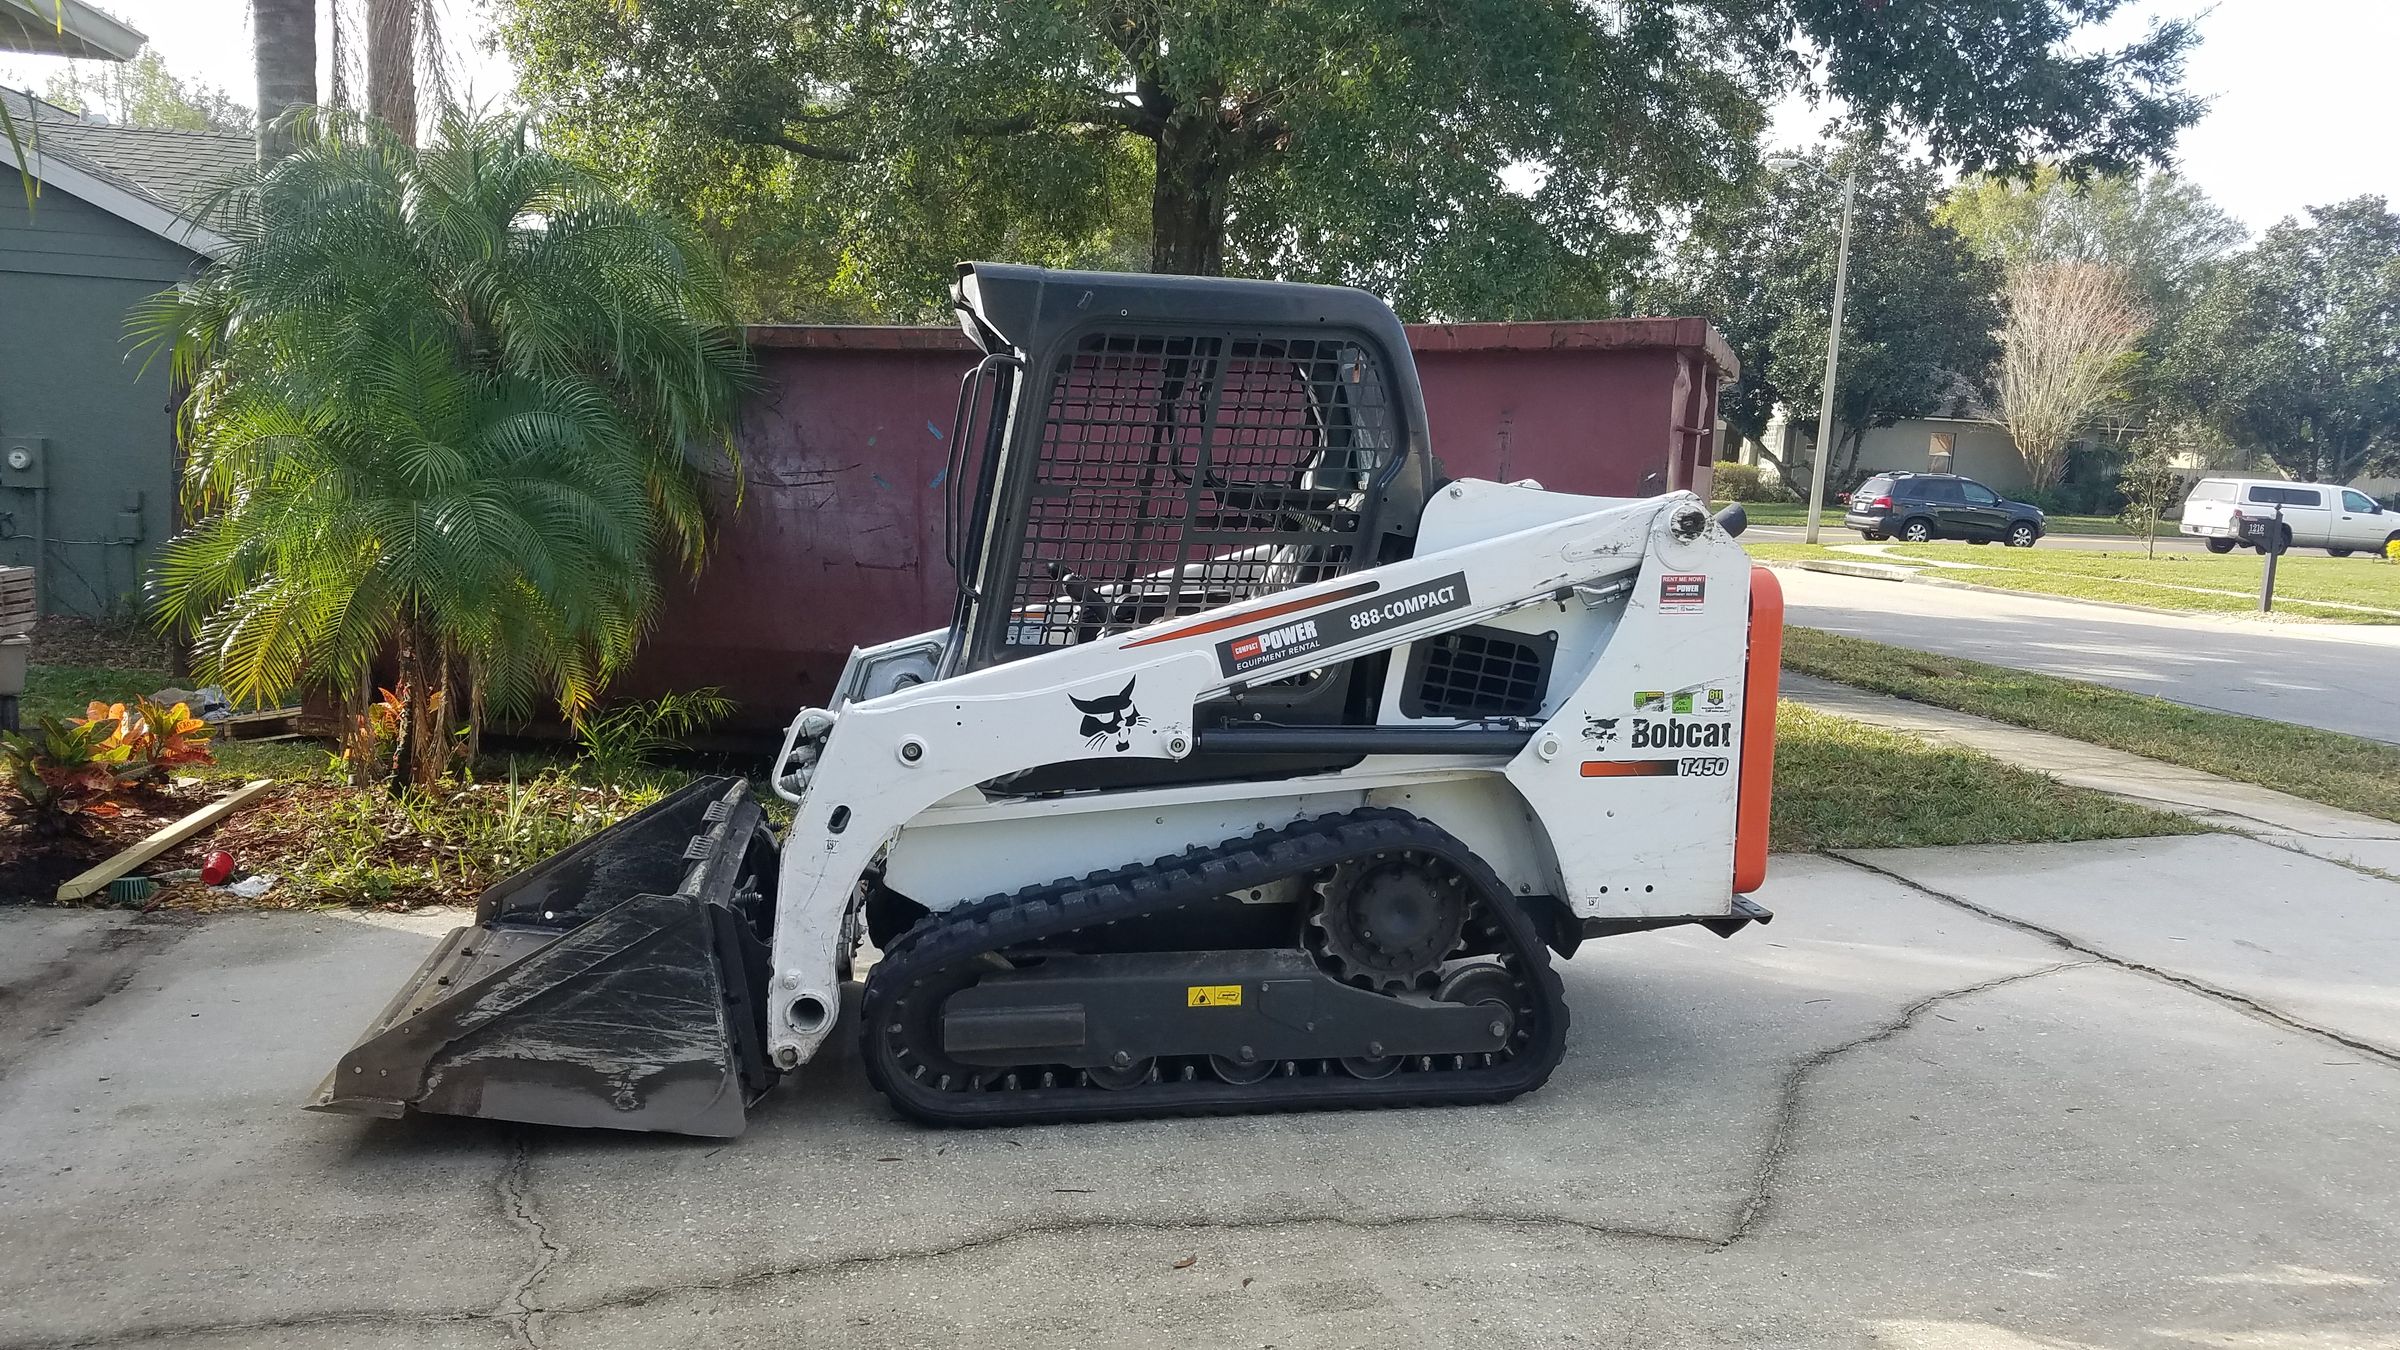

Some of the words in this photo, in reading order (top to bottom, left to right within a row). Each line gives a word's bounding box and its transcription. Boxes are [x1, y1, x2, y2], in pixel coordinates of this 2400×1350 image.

[2249, 523, 2265, 532] 1216
[1676, 584, 1699, 593] POWER
[1349, 586, 1455, 630] 888-COMPACT
[1234, 641, 1259, 655] COMPACT
[1257, 620, 1318, 653] POWER
[1236, 650, 1286, 671] EQUIPMENT
[1288, 640, 1321, 656] RENTAL
[1709, 690, 1722, 700] 811
[1632, 718, 1731, 748] Bobcat
[1682, 758, 1729, 776] T450
